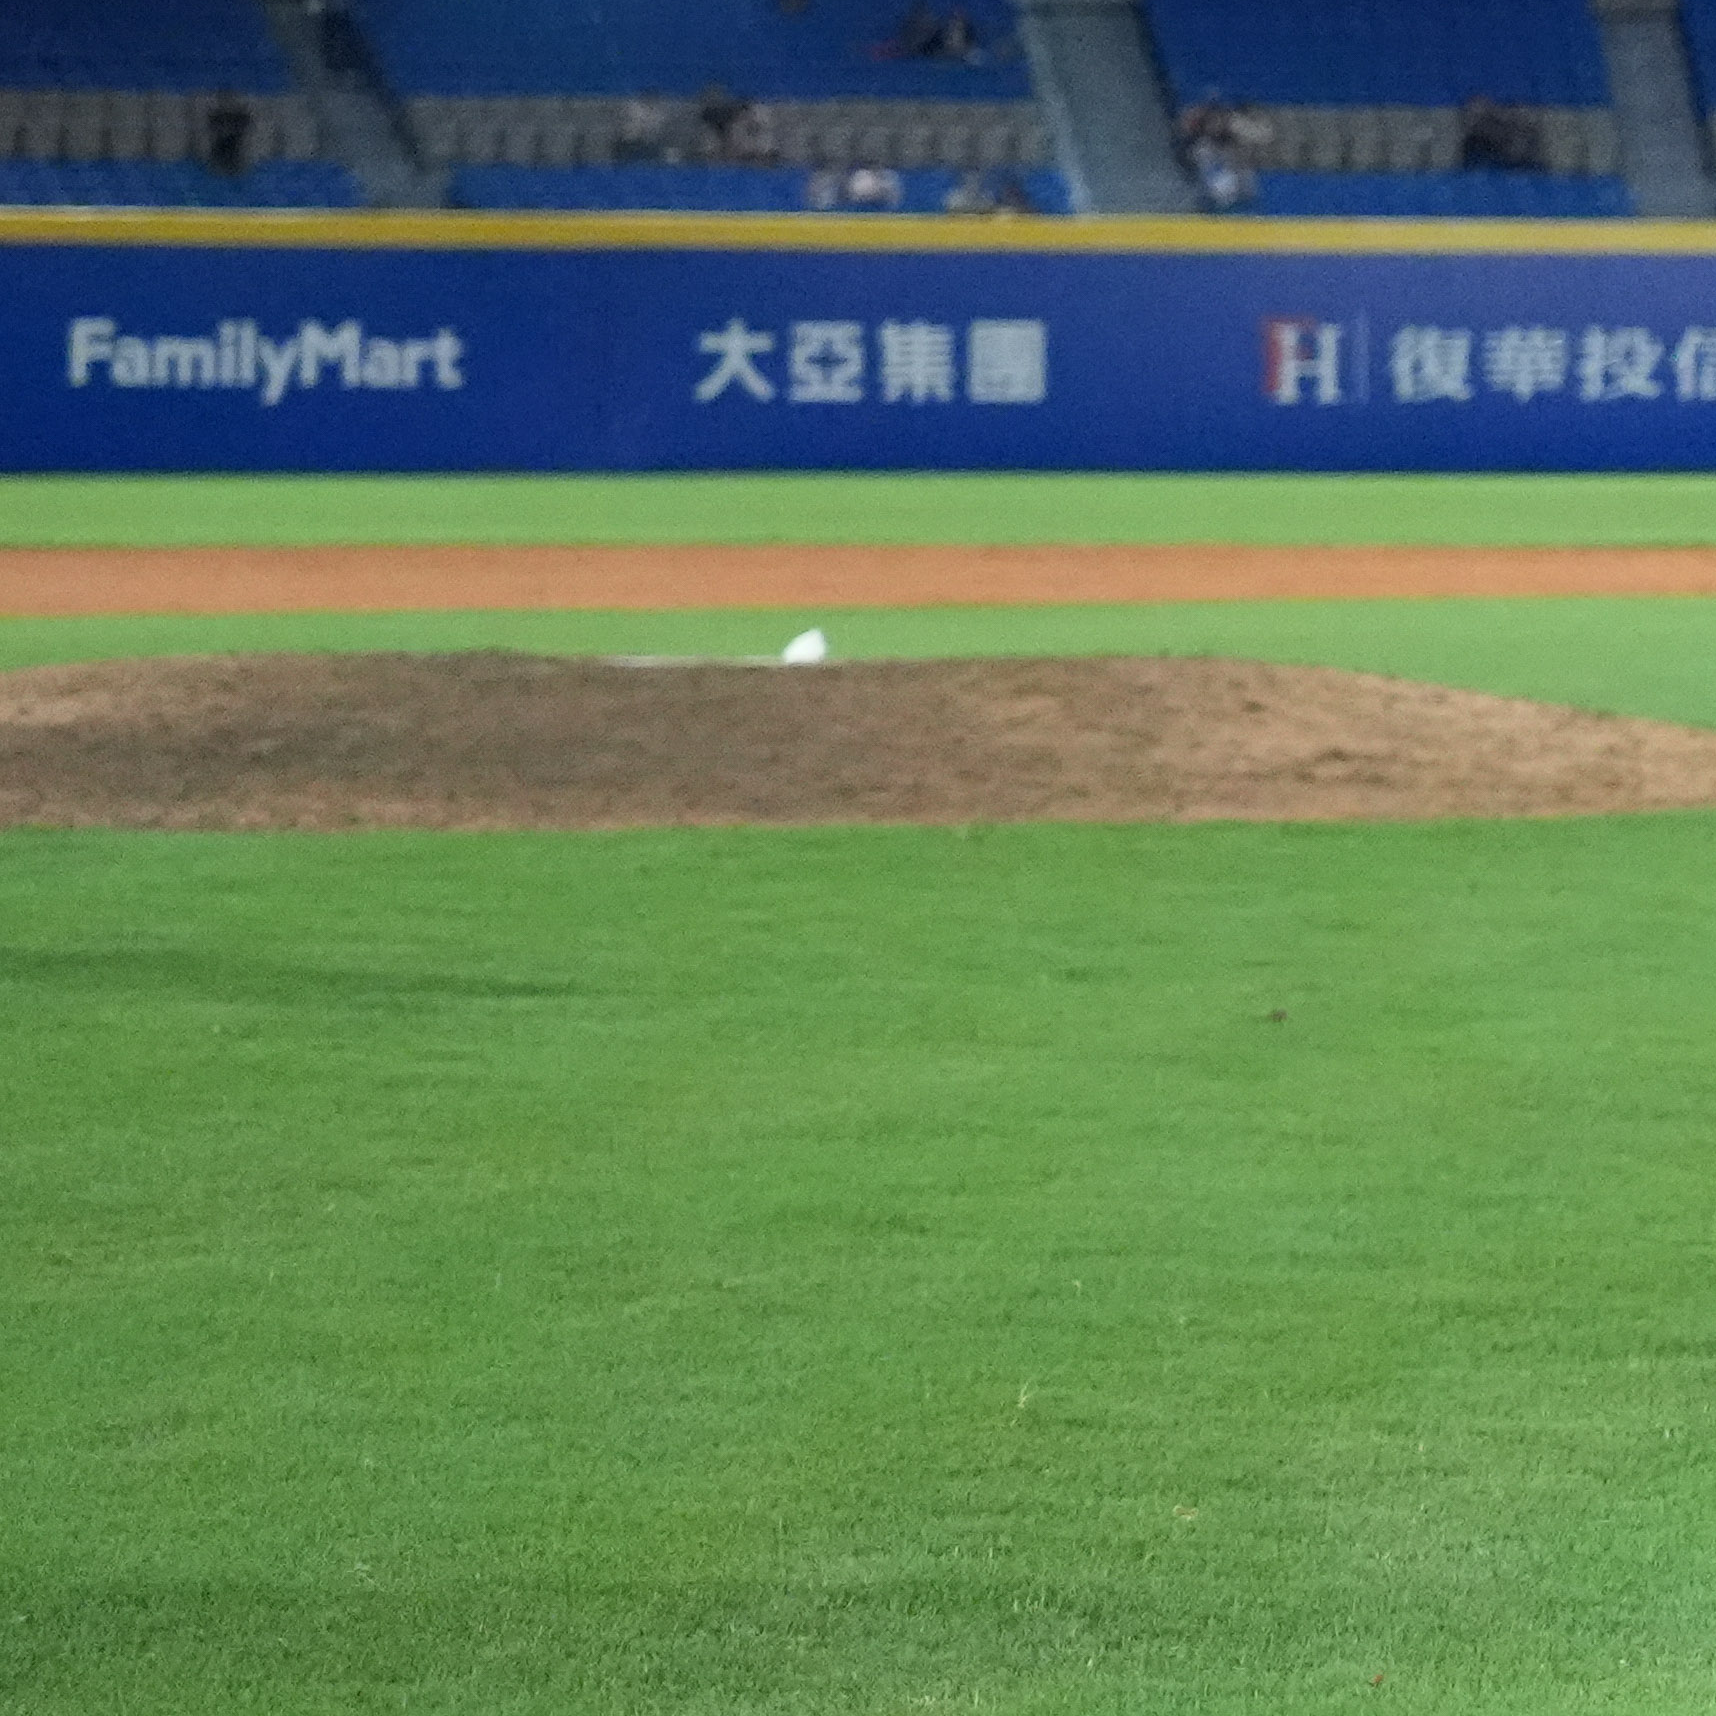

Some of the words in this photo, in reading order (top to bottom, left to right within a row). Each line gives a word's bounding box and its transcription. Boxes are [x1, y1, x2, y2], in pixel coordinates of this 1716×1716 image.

[67, 317, 465, 406] FamilyMart
[695, 317, 1047, 404] 大亞集團
